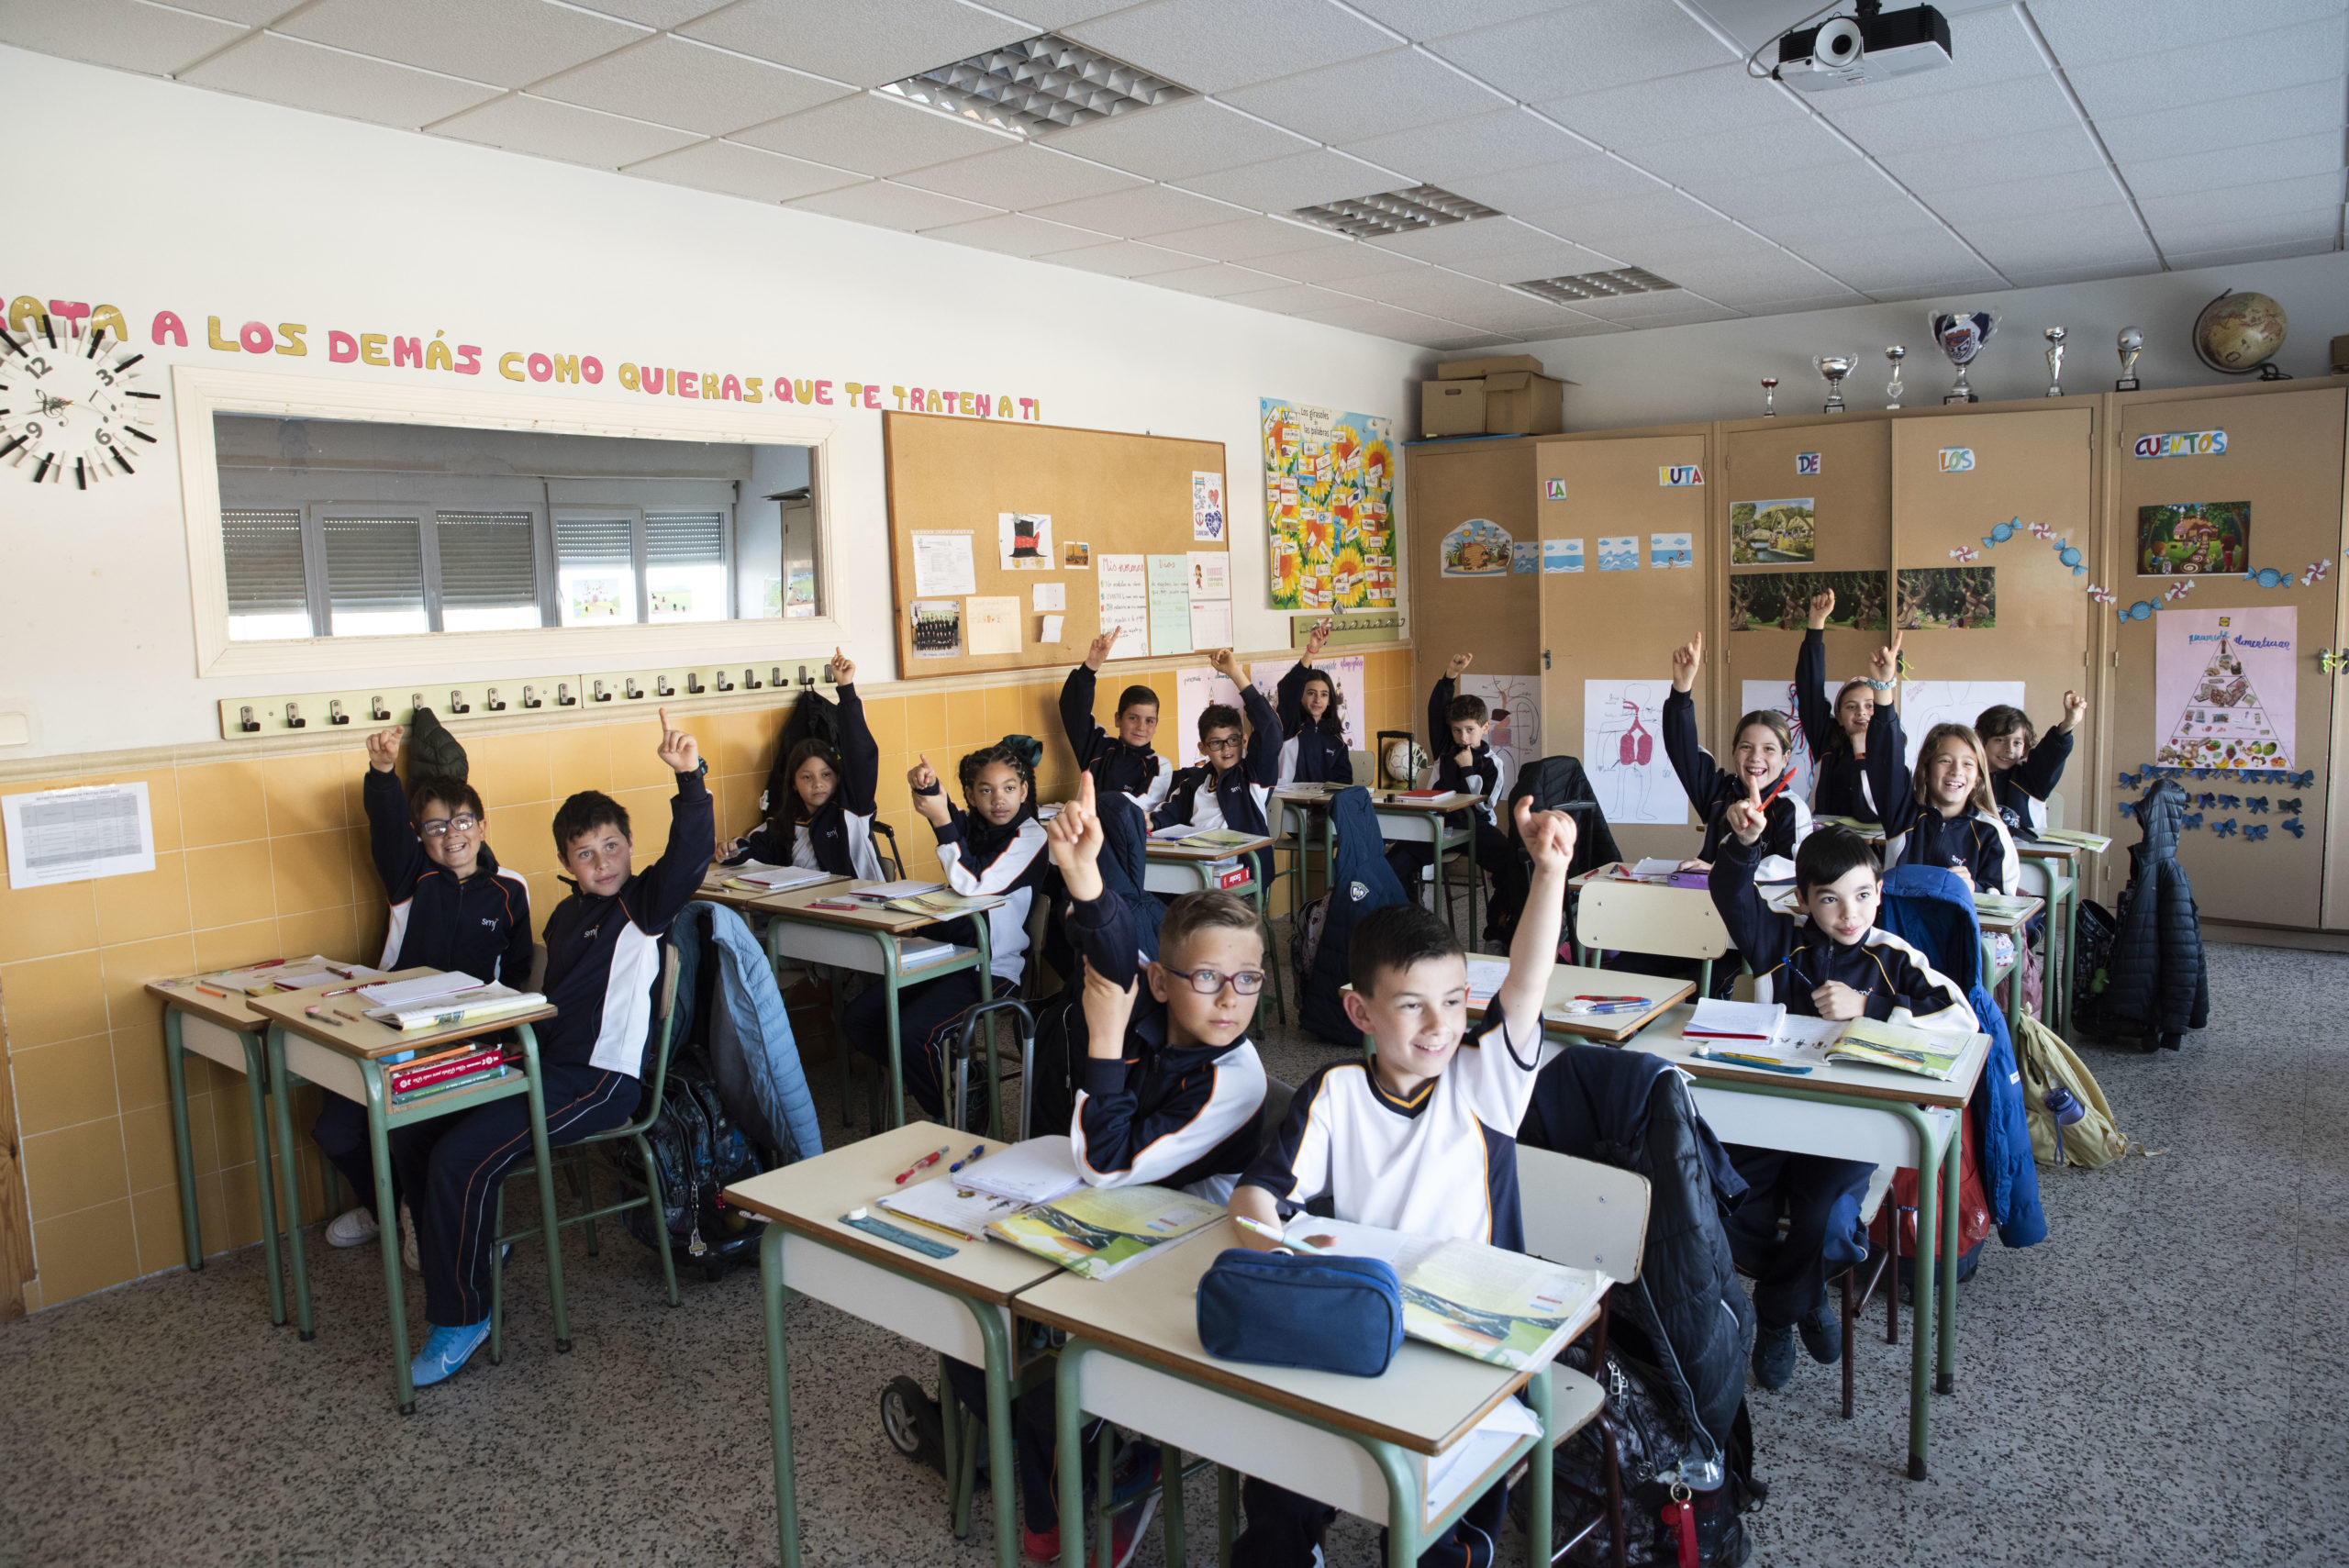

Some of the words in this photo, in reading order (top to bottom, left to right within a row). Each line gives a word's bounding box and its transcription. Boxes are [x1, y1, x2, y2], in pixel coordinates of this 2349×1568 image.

[0, 295, 128, 341] ATA
[152, 311, 187, 346] A
[208, 317, 307, 356] LOS
[328, 330, 481, 374] DEMÁS
[499, 352, 603, 384] COMO
[619, 363, 763, 403] QUIERAS
[775, 377, 832, 405] QUE
[845, 383, 881, 408] TE
[893, 385, 990, 417] TRATEN
[997, 395, 1013, 418] A
[1019, 397, 1040, 421] TI
[25, 357, 53, 379] 12
[95, 369, 114, 386] 3
[1309, 408, 1330, 421] girasoles
[26, 422, 42, 439] 9
[95, 428, 112, 445] 6
[1547, 481, 1564, 497] LA
[1661, 466, 1702, 484] RUTA
[1798, 455, 1819, 473] DE
[1940, 450, 1973, 470] LOS
[2134, 432, 2226, 456] CUENTOS
